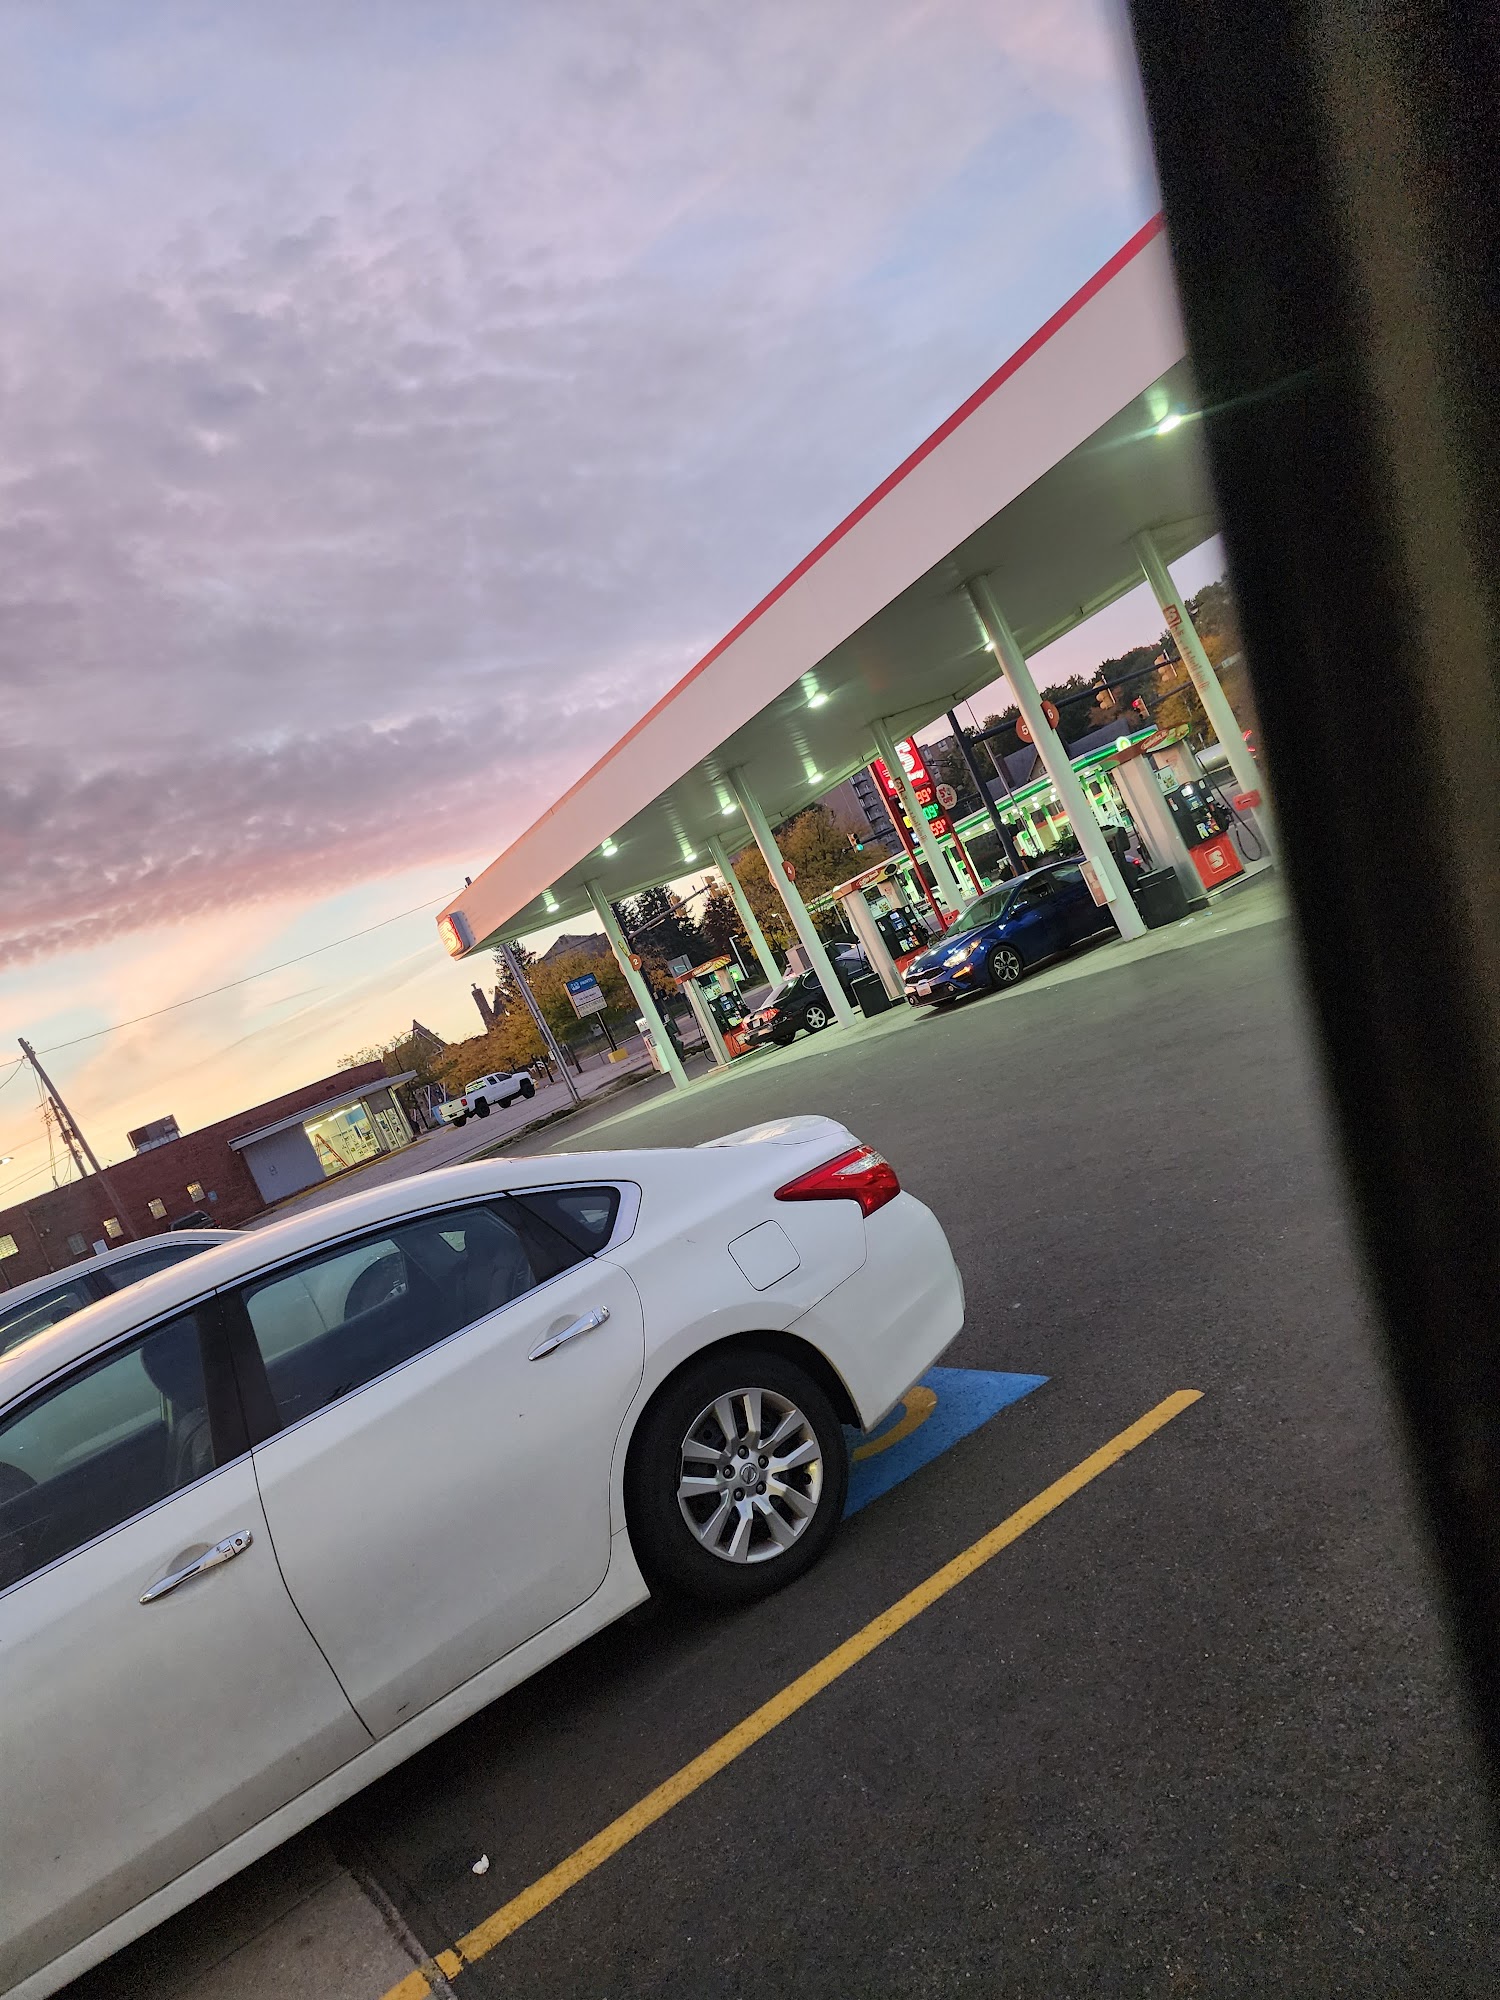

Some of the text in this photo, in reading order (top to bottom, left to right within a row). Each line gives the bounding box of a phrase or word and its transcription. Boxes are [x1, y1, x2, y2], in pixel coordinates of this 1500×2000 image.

[1047, 708, 1054, 720] 6
[1021, 725, 1029, 735] 5
[1208, 850, 1224, 868] S
[632, 958, 639, 966] 2
